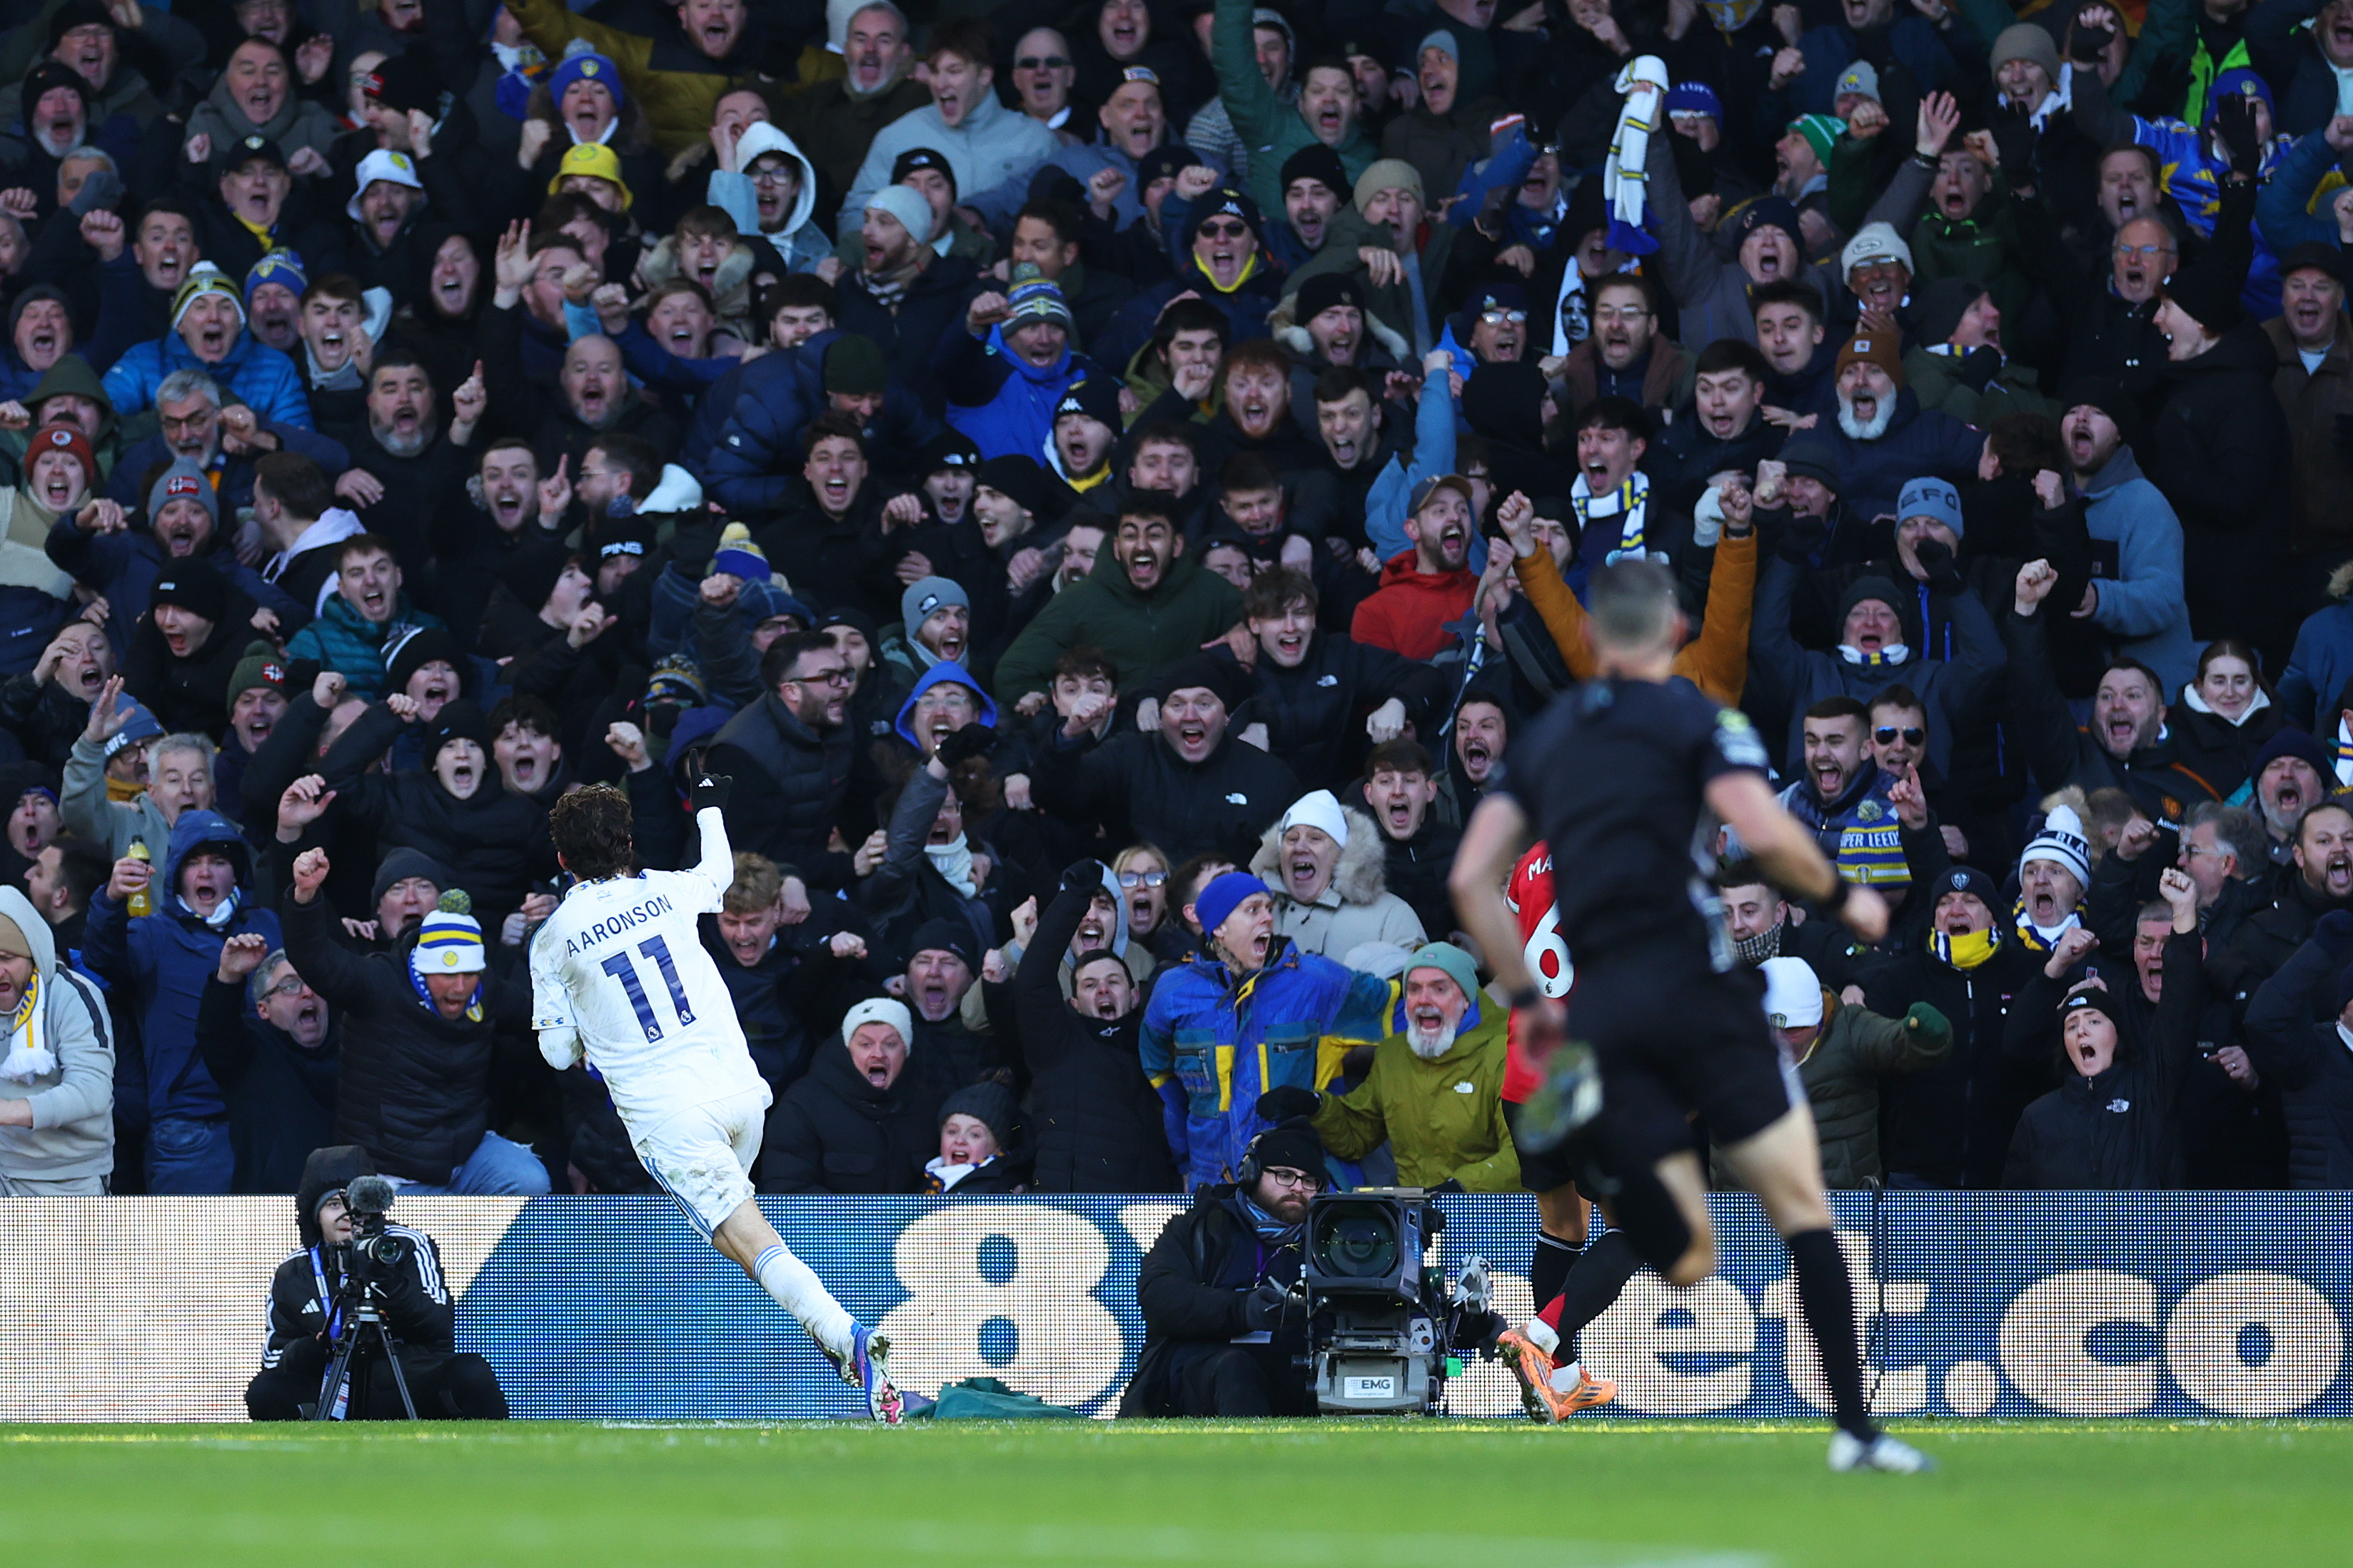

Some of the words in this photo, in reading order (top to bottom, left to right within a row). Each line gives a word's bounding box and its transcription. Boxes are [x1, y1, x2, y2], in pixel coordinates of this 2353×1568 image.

[566, 894, 672, 958] AARONSON
[1523, 897, 1575, 998] 6
[600, 934, 697, 1044] 11
[1361, 1379, 1391, 1389] EMG
